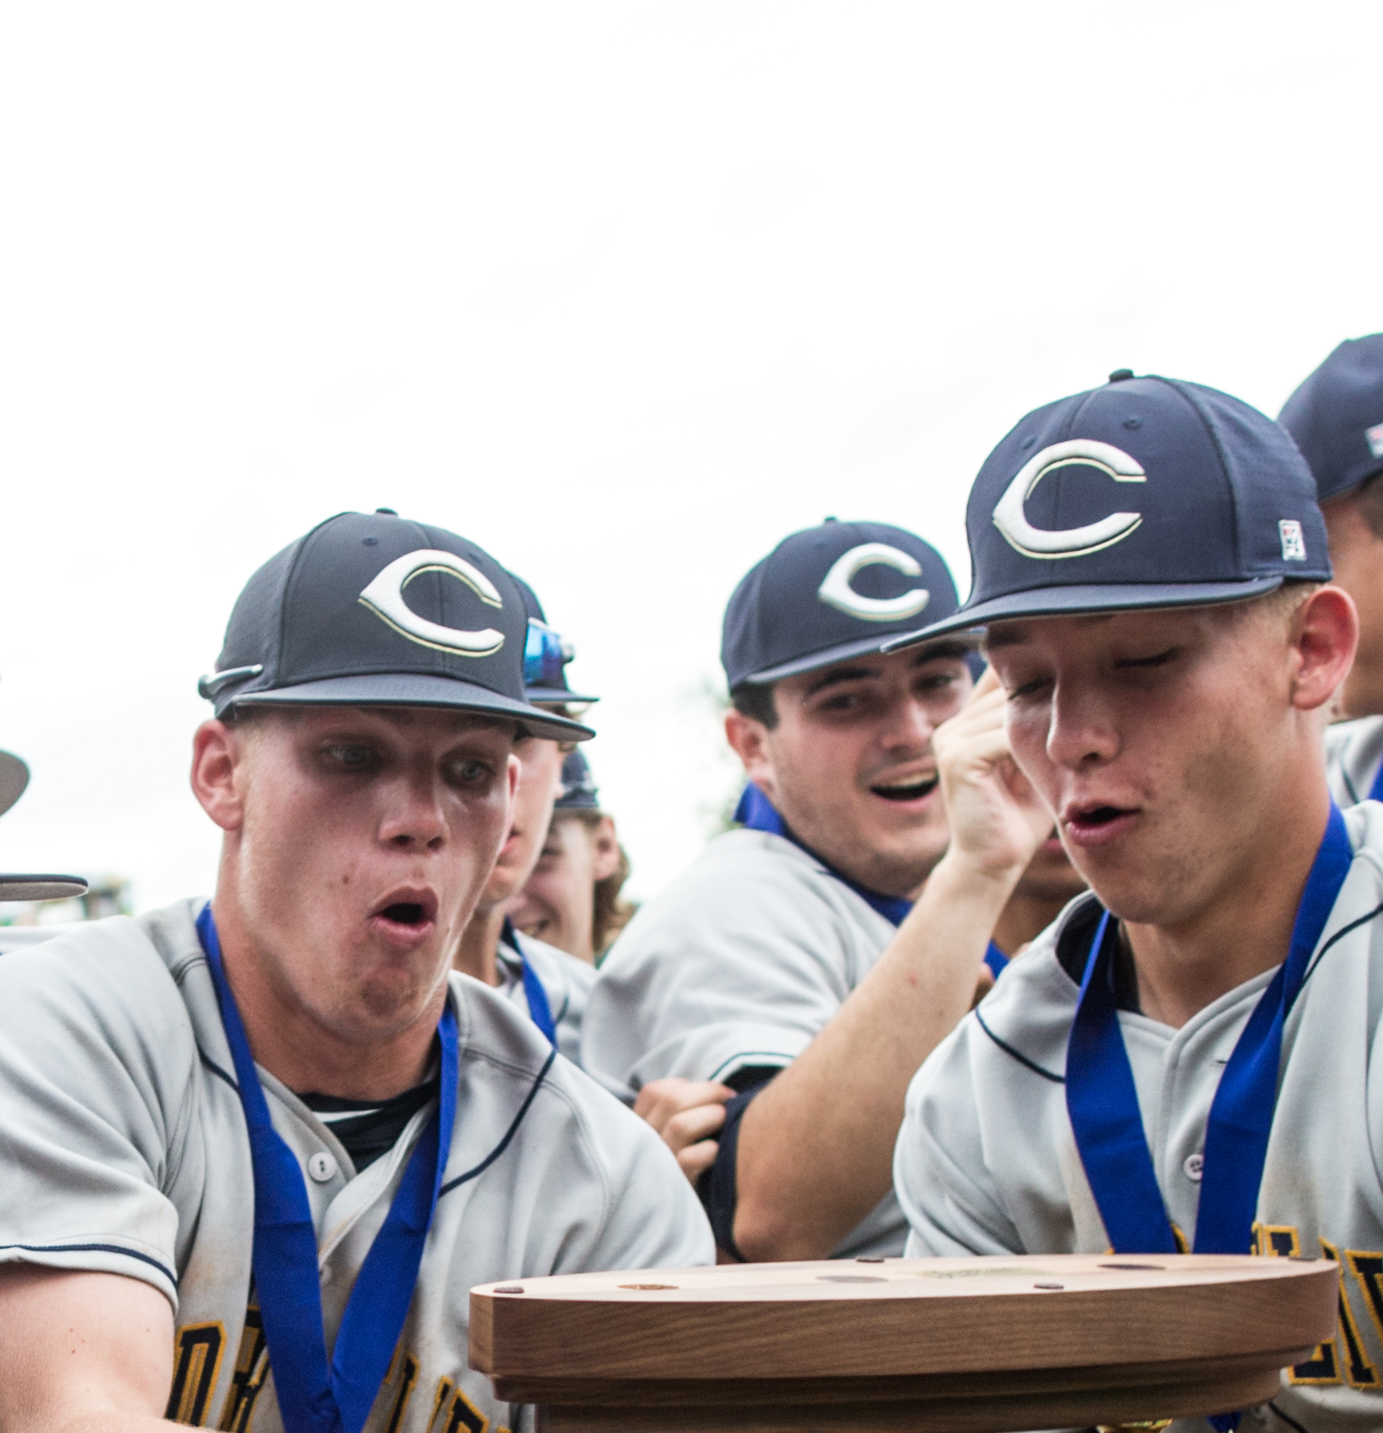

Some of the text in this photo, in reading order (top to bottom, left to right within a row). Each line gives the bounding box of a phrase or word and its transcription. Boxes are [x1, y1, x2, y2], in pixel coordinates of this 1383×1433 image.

[993, 438, 1147, 560] C
[358, 548, 505, 658] C
[819, 542, 931, 622] C
